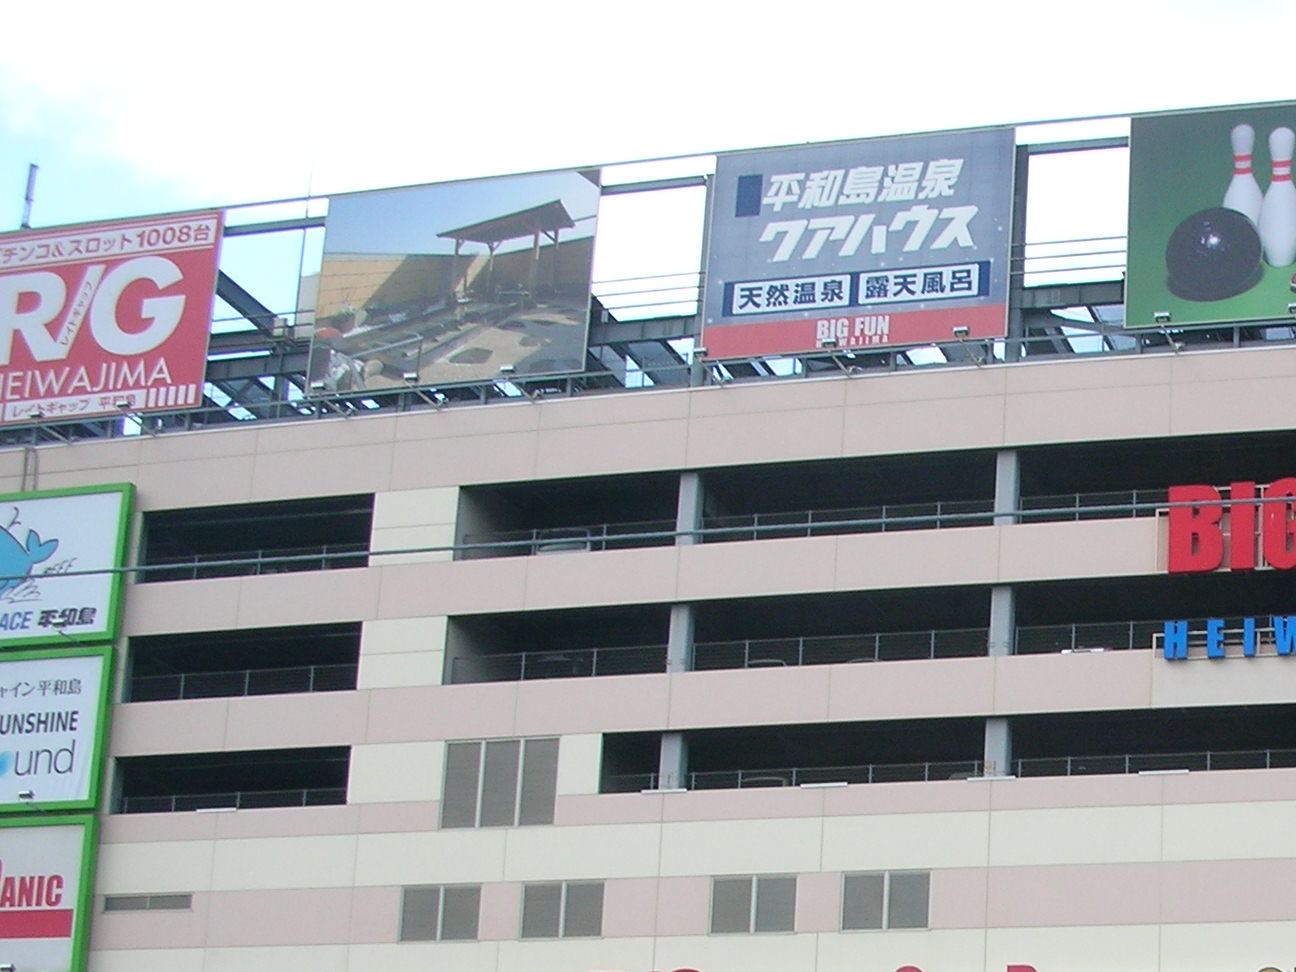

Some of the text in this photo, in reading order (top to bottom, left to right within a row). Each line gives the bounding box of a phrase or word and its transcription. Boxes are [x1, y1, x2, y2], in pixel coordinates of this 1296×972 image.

[762, 159, 963, 212] 平和島温泉
[0, 225, 211, 264] チンコ&スロット1008台
[759, 204, 978, 262] クアハウス
[738, 270, 973, 309] 天然温泉 露天風呂
[817, 315, 890, 339] BIG FUN
[0, 862, 64, 908] ANIC
